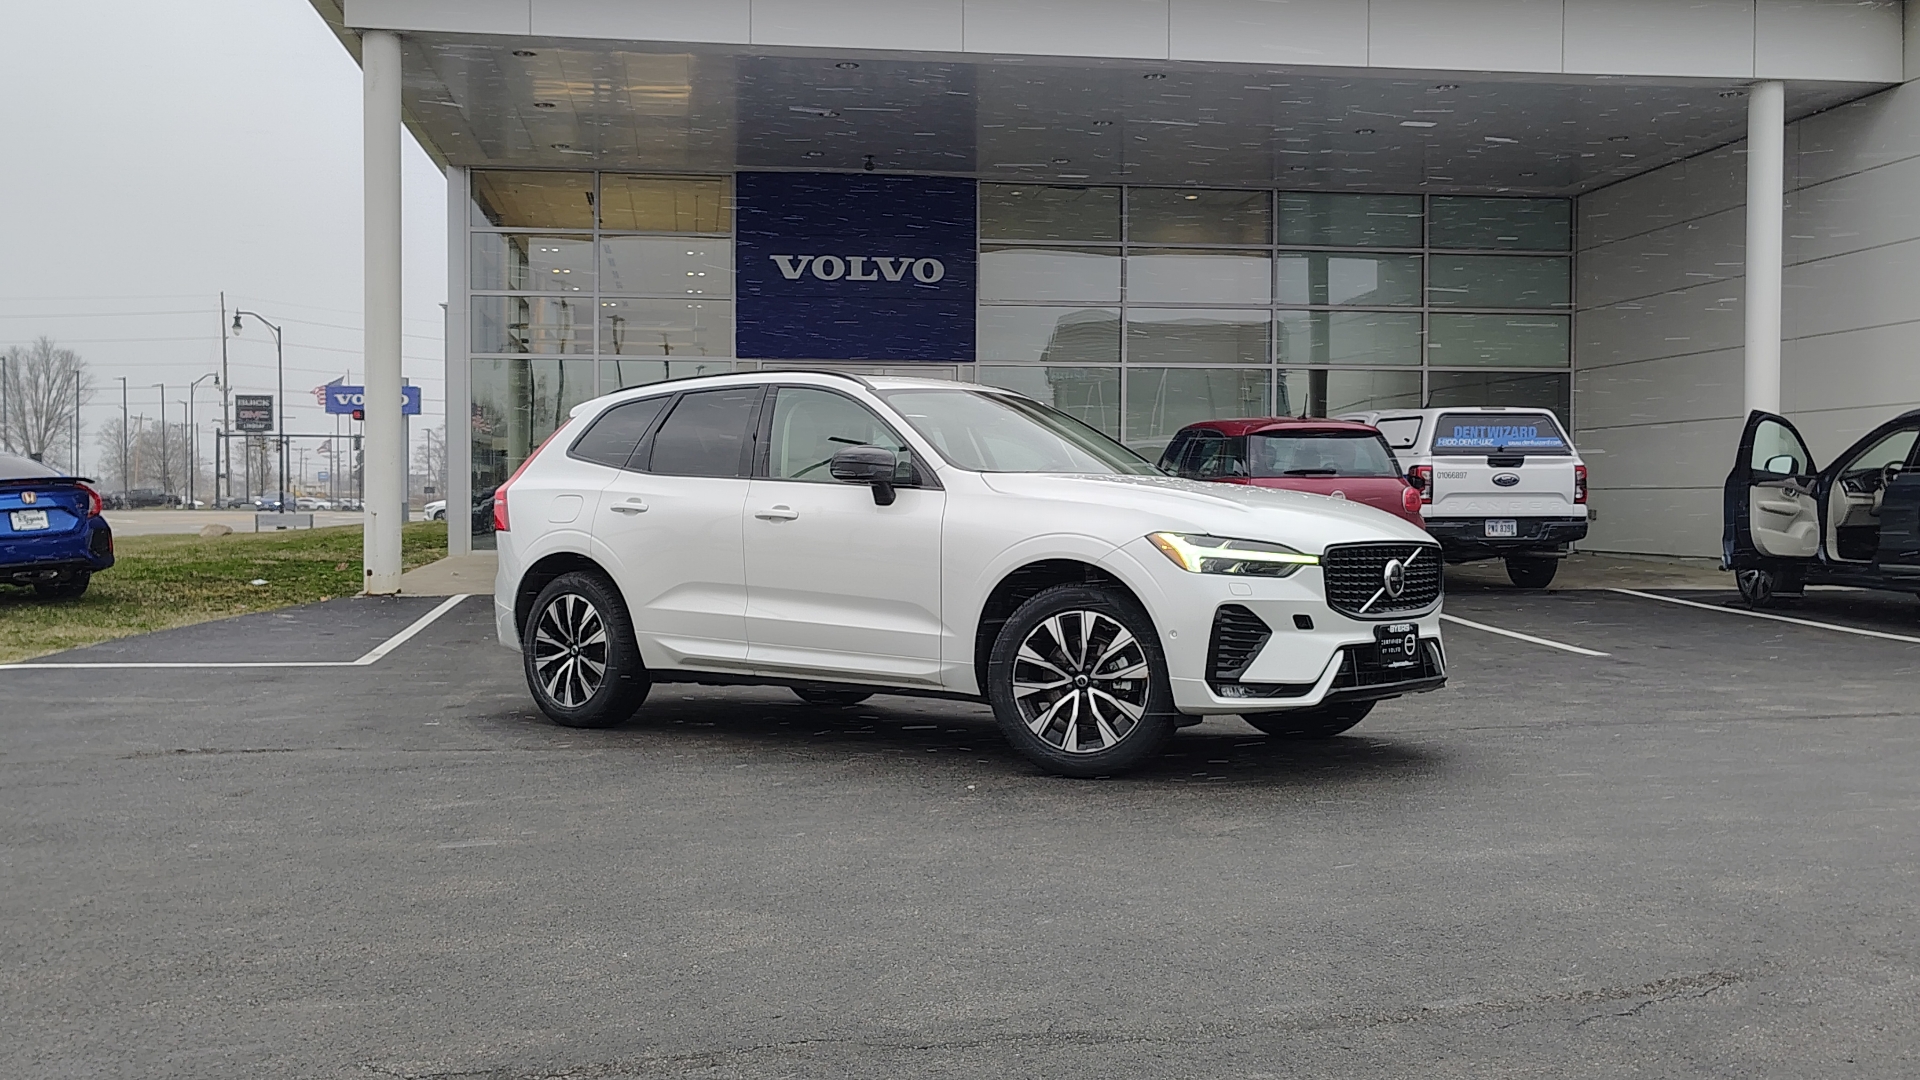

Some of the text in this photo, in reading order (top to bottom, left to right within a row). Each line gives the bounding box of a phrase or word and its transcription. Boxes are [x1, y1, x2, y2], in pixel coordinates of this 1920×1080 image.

[769, 254, 945, 283] VOLVO
[237, 399, 271, 407] BUICK
[334, 393, 410, 406] VOO
[239, 410, 270, 420] GMC
[1436, 471, 1468, 479] 01066897
[1446, 501, 1561, 511] RANGER
[1390, 624, 1410, 633] BYERS
